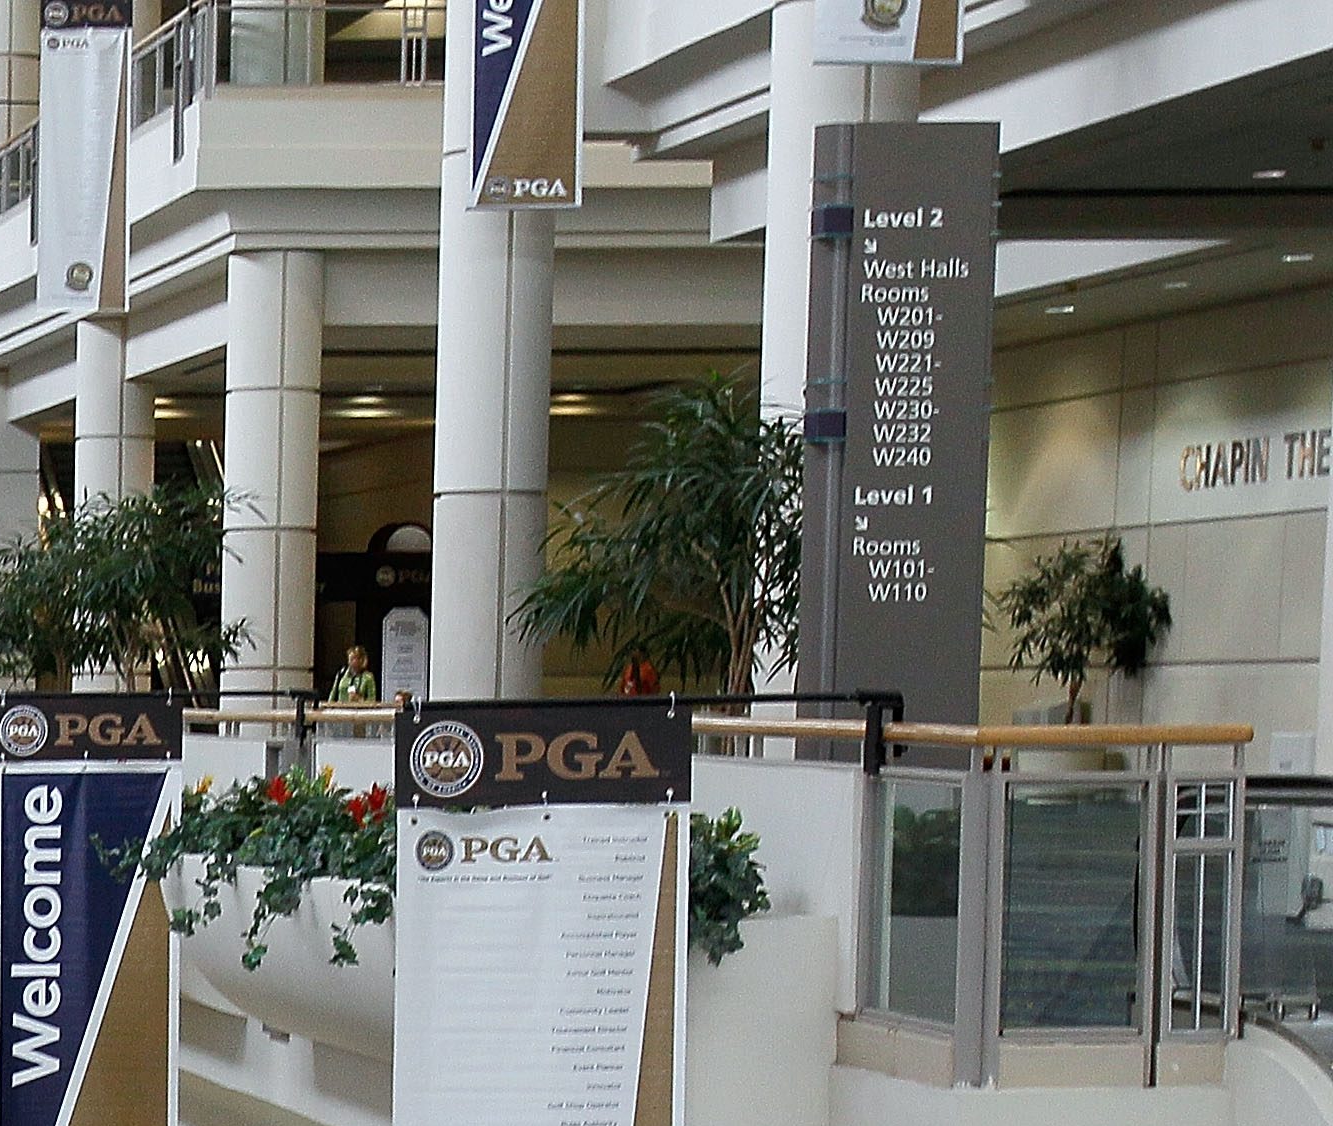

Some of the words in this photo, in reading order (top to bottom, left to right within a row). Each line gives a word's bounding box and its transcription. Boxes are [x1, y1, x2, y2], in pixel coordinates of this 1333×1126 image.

[70, 3, 123, 23] PGA
[513, 178, 568, 197] PGA
[864, 207, 923, 229] Level
[930, 208, 944, 229] 2
[863, 258, 914, 280] West
[921, 256, 969, 279] Halls
[861, 283, 930, 304] Rooms
[876, 306, 944, 327] W201-
[876, 329, 935, 350] W209
[875, 353, 941, 374] W221-
[874, 376, 934, 397] W225
[873, 400, 940, 420] W230-
[873, 423, 932, 444] W232
[872, 447, 932, 467] W240
[1180, 434, 1270, 493] CHAPIN
[854, 484, 914, 506] Level
[922, 485, 933, 505] 1
[853, 536, 921, 557] Rooms
[868, 558, 935, 579] W101-
[868, 582, 928, 602] W110
[54, 713, 163, 747] PGA
[423, 750, 471, 769] PGA
[494, 730, 661, 782] PGA
[459, 835, 553, 864] PGA
[11, 783, 63, 1088] Welcome
